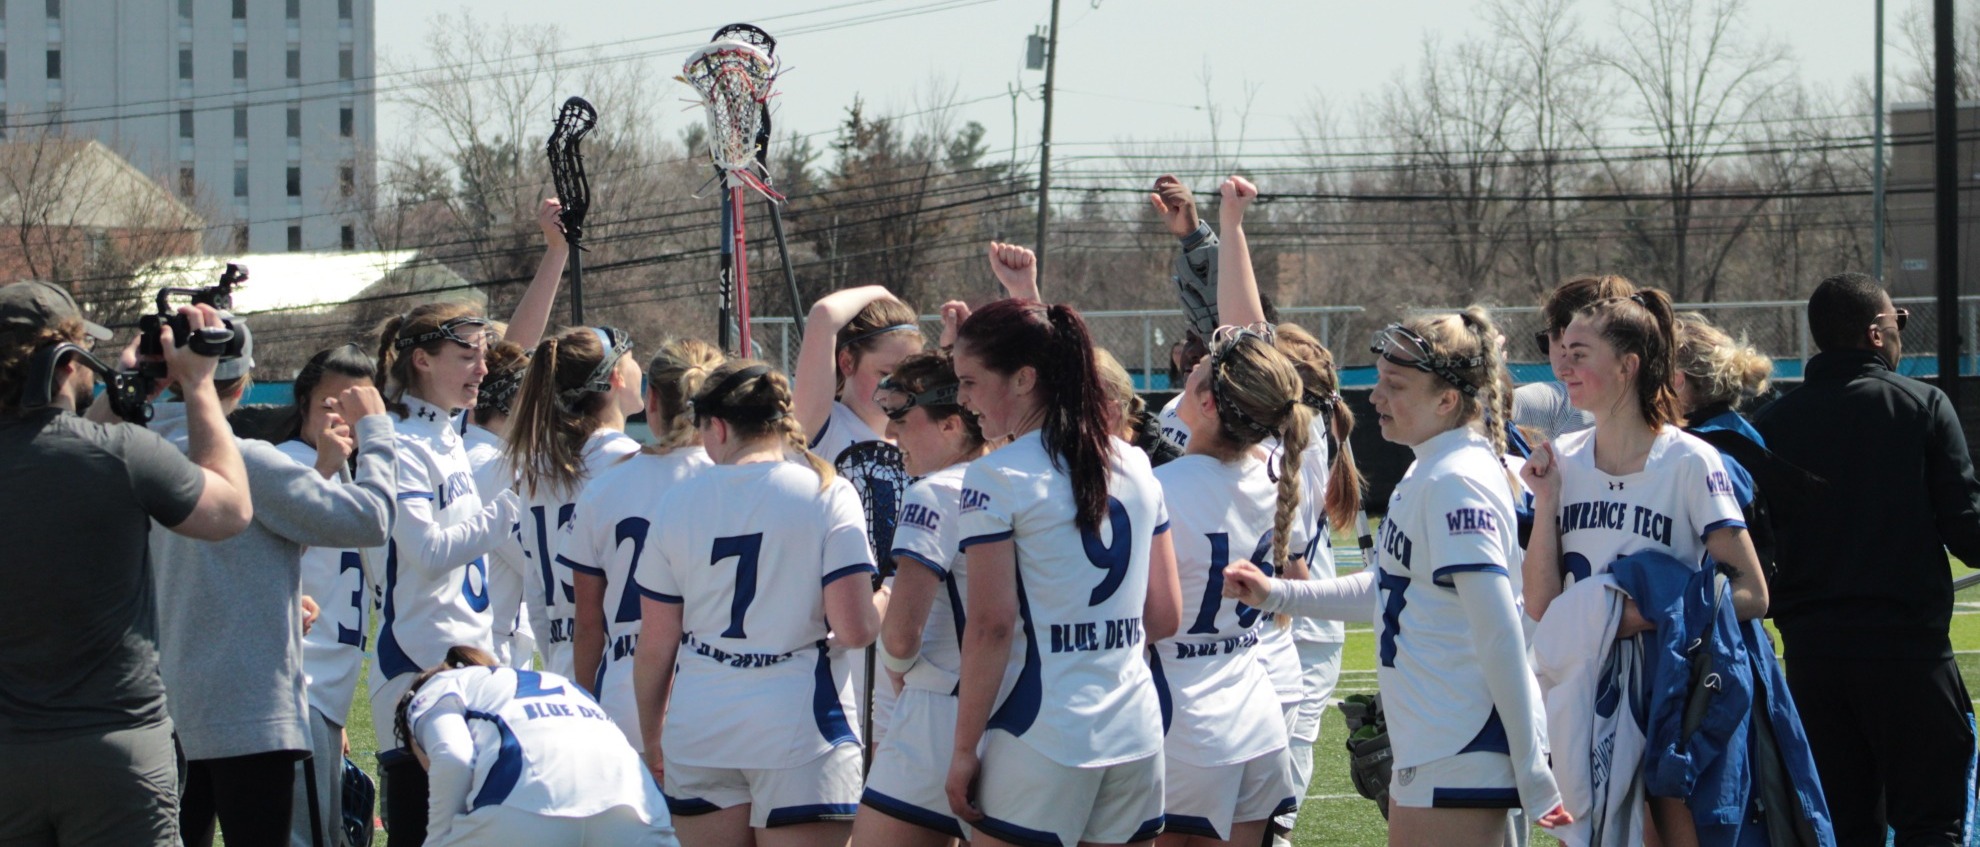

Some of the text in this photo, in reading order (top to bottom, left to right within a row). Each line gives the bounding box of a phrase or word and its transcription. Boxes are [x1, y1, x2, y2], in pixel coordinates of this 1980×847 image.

[1446, 508, 1496, 531] WHAC
[1560, 501, 1627, 535] AWRENCE
[1082, 495, 1132, 607] 9
[710, 532, 763, 639] 7
[1050, 622, 1099, 653] BLUE
[523, 701, 574, 720] BLUE
